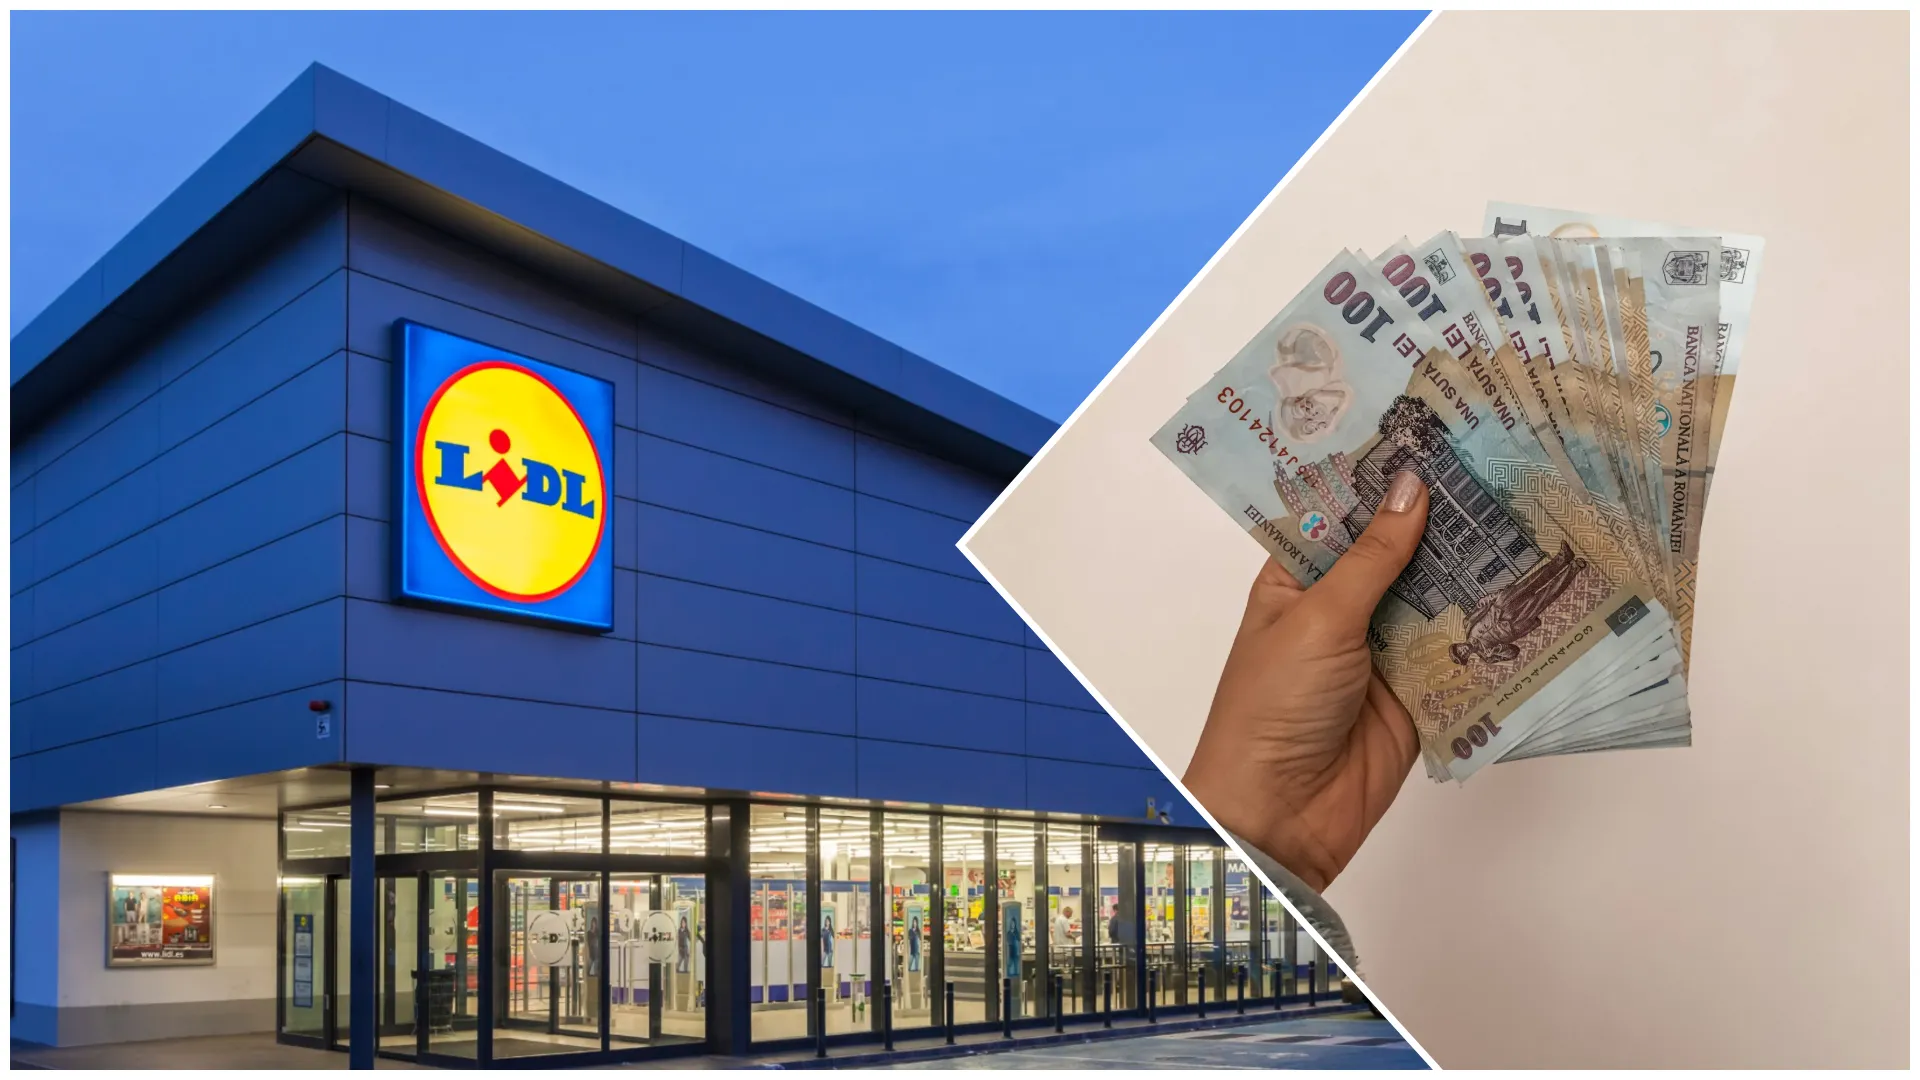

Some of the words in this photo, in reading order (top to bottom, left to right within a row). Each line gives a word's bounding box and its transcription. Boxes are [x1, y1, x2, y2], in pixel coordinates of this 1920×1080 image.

[1324, 271, 1394, 343] 100
[1382, 254, 1447, 321] 100
[1392, 333, 1426, 368] LEI
[1442, 323, 1472, 360] LEI
[1684, 325, 1699, 376] BANCA
[1422, 361, 1456, 400] SUTĂ
[1466, 356, 1497, 396] SUTĂ
[1455, 397, 1480, 430] UNA
[1492, 395, 1516, 430] UNA
[1675, 469, 1687, 479] A
[1244, 504, 1301, 560] ROMÂNIEI
[1671, 480, 1687, 554] ROMÂNIEI
[1451, 711, 1502, 760] 100
